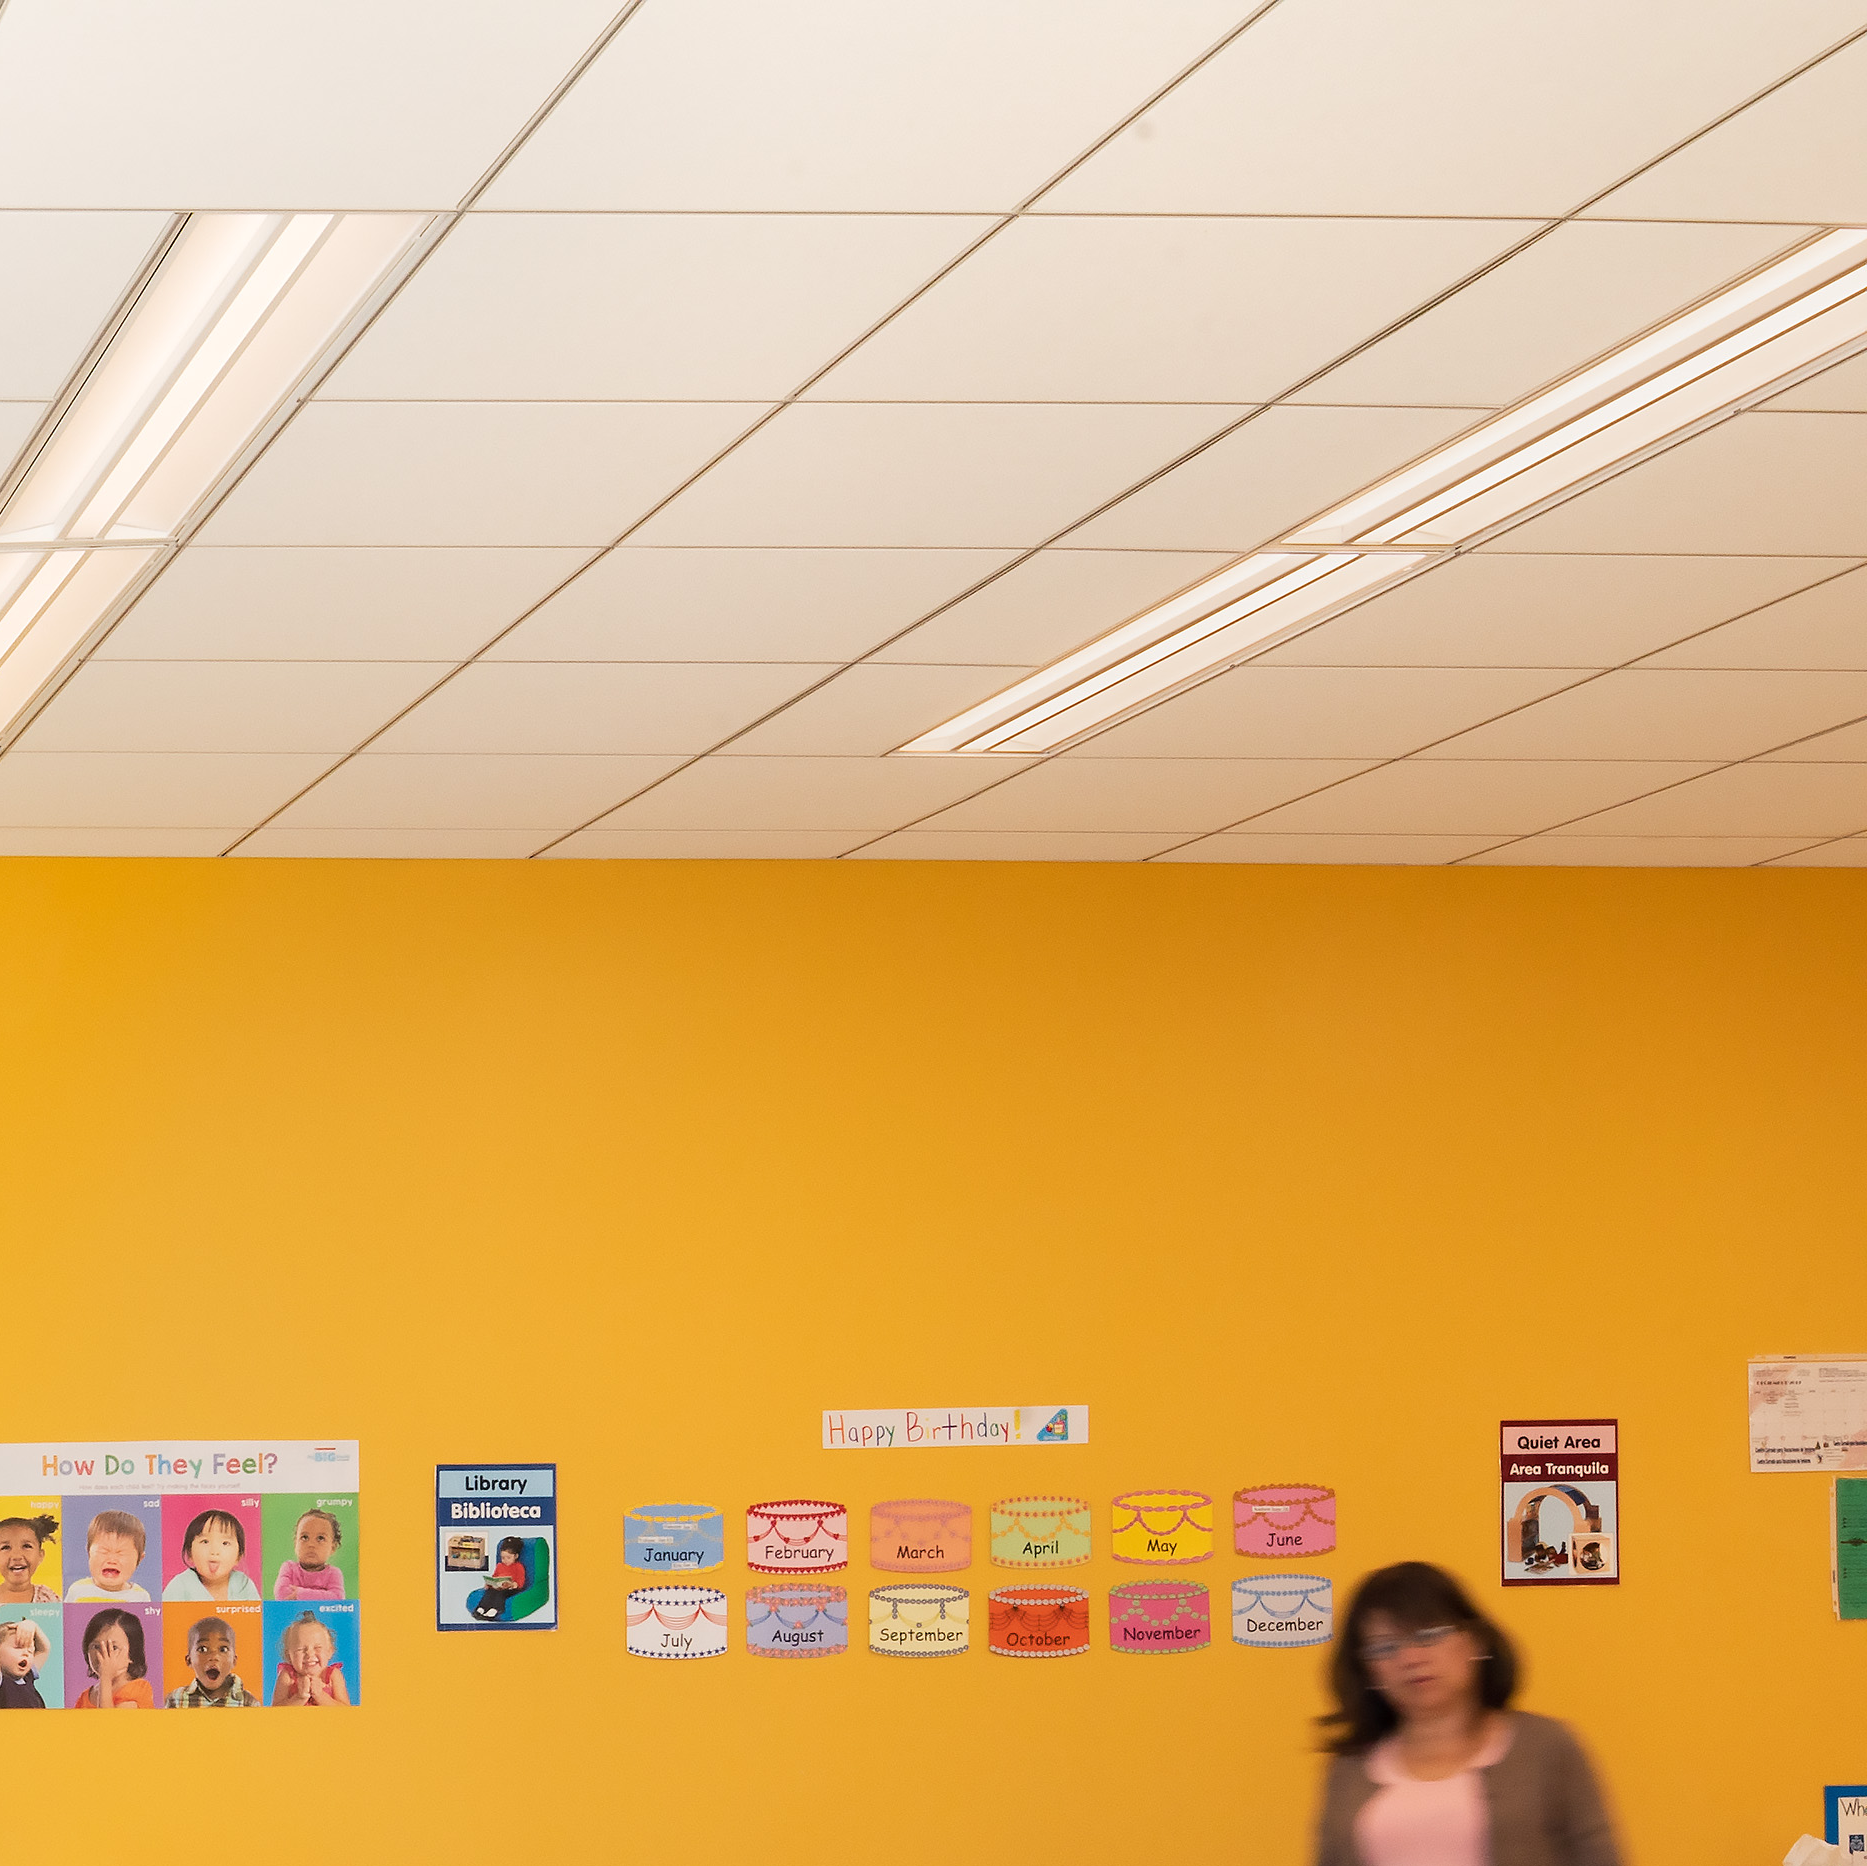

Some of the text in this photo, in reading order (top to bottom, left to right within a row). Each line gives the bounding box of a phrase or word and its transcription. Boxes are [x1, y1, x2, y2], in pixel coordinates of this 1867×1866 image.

[828, 1410, 1022, 1447] Happy Birthday!
[1517, 1434, 1601, 1451] Quiet Area
[41, 1452, 279, 1479] How Do They Feel?
[1509, 1461, 1610, 1477] Area Tranquila
[465, 1474, 528, 1495] Library
[30, 1500, 60, 1510] happy
[143, 1499, 160, 1508] sad
[241, 1497, 259, 1508] silly
[316, 1498, 353, 1508] grumpy
[450, 1502, 542, 1520] Biblioteca
[1147, 1539, 1178, 1556] May
[1266, 1532, 1303, 1547] June
[643, 1548, 705, 1564] January
[764, 1544, 834, 1562] February
[896, 1545, 945, 1559] March
[1022, 1541, 1059, 1559] April
[30, 1607, 60, 1618] sleepy
[144, 1606, 161, 1617] shy
[215, 1604, 261, 1615] surprised
[319, 1604, 354, 1613] excited
[1247, 1617, 1324, 1633] December
[661, 1633, 693, 1651] July
[771, 1629, 824, 1646] August
[879, 1627, 963, 1646] September
[1006, 1632, 1071, 1647] October
[1123, 1627, 1201, 1641] November
